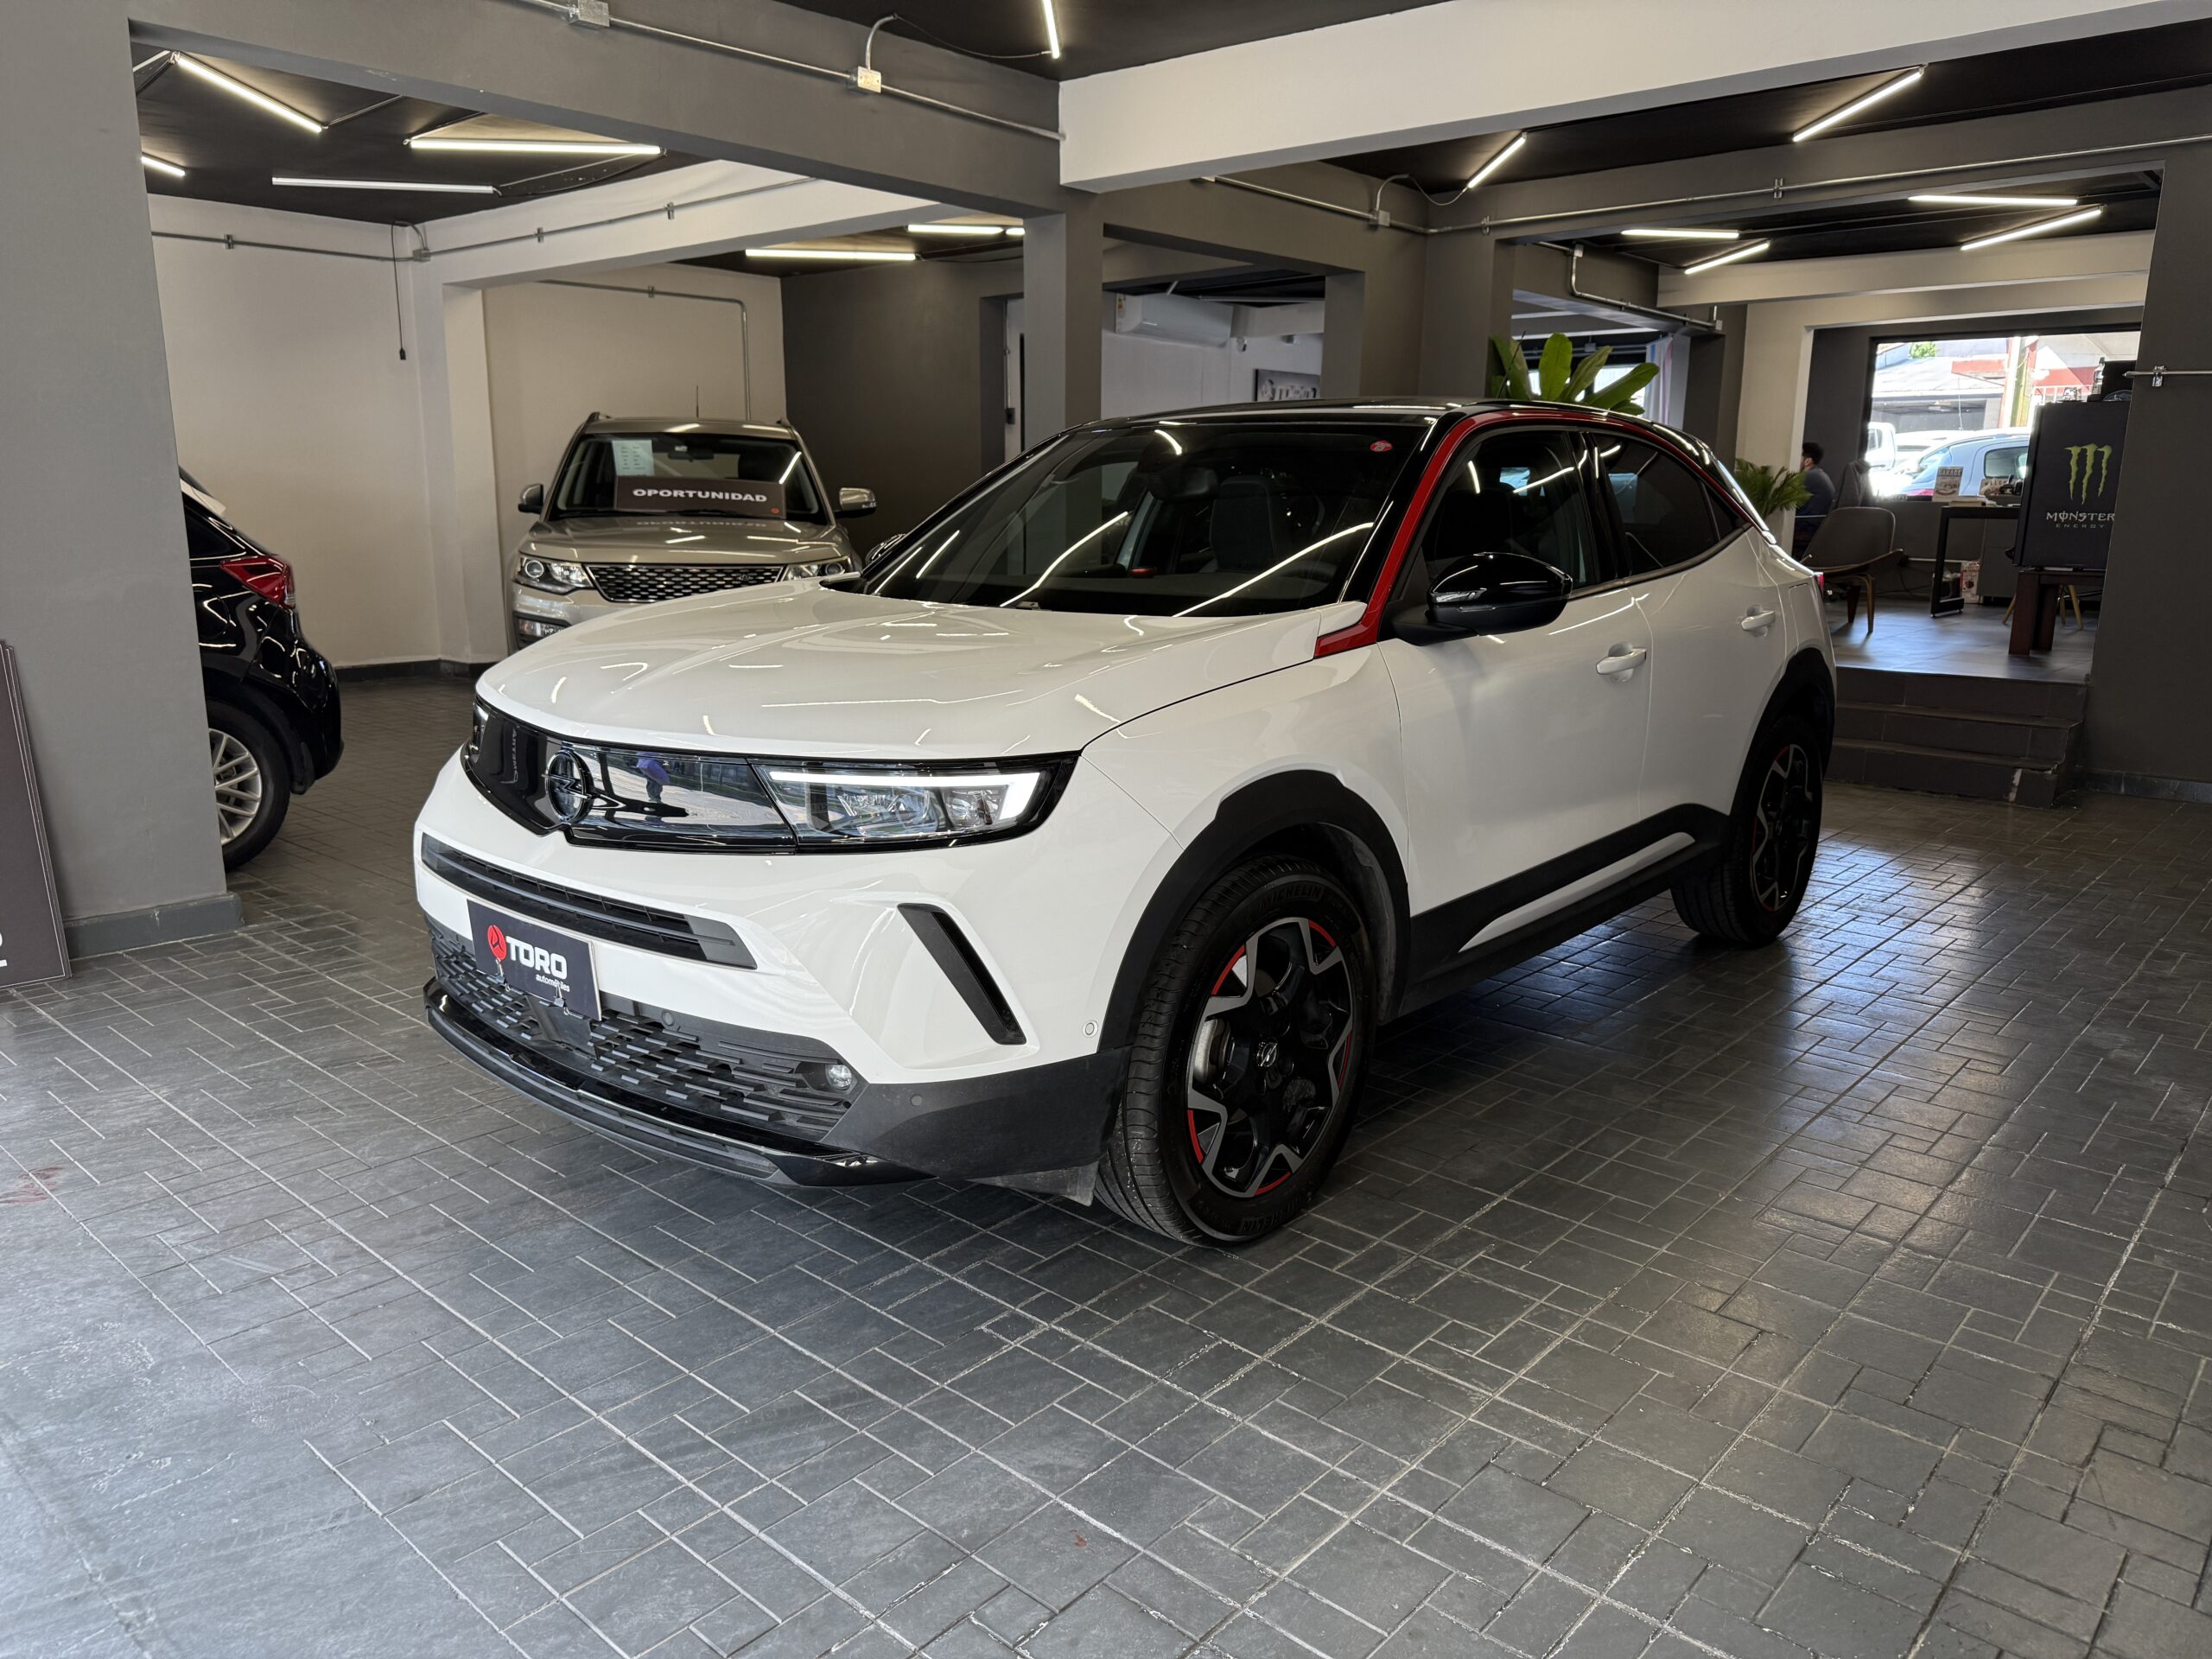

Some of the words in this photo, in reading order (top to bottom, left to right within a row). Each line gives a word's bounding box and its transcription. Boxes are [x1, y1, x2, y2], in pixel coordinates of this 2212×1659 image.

[632, 489, 767, 502] OPORTUNIDAD
[2045, 511, 2115, 523] MONSTER
[505, 935, 568, 980] TORO
